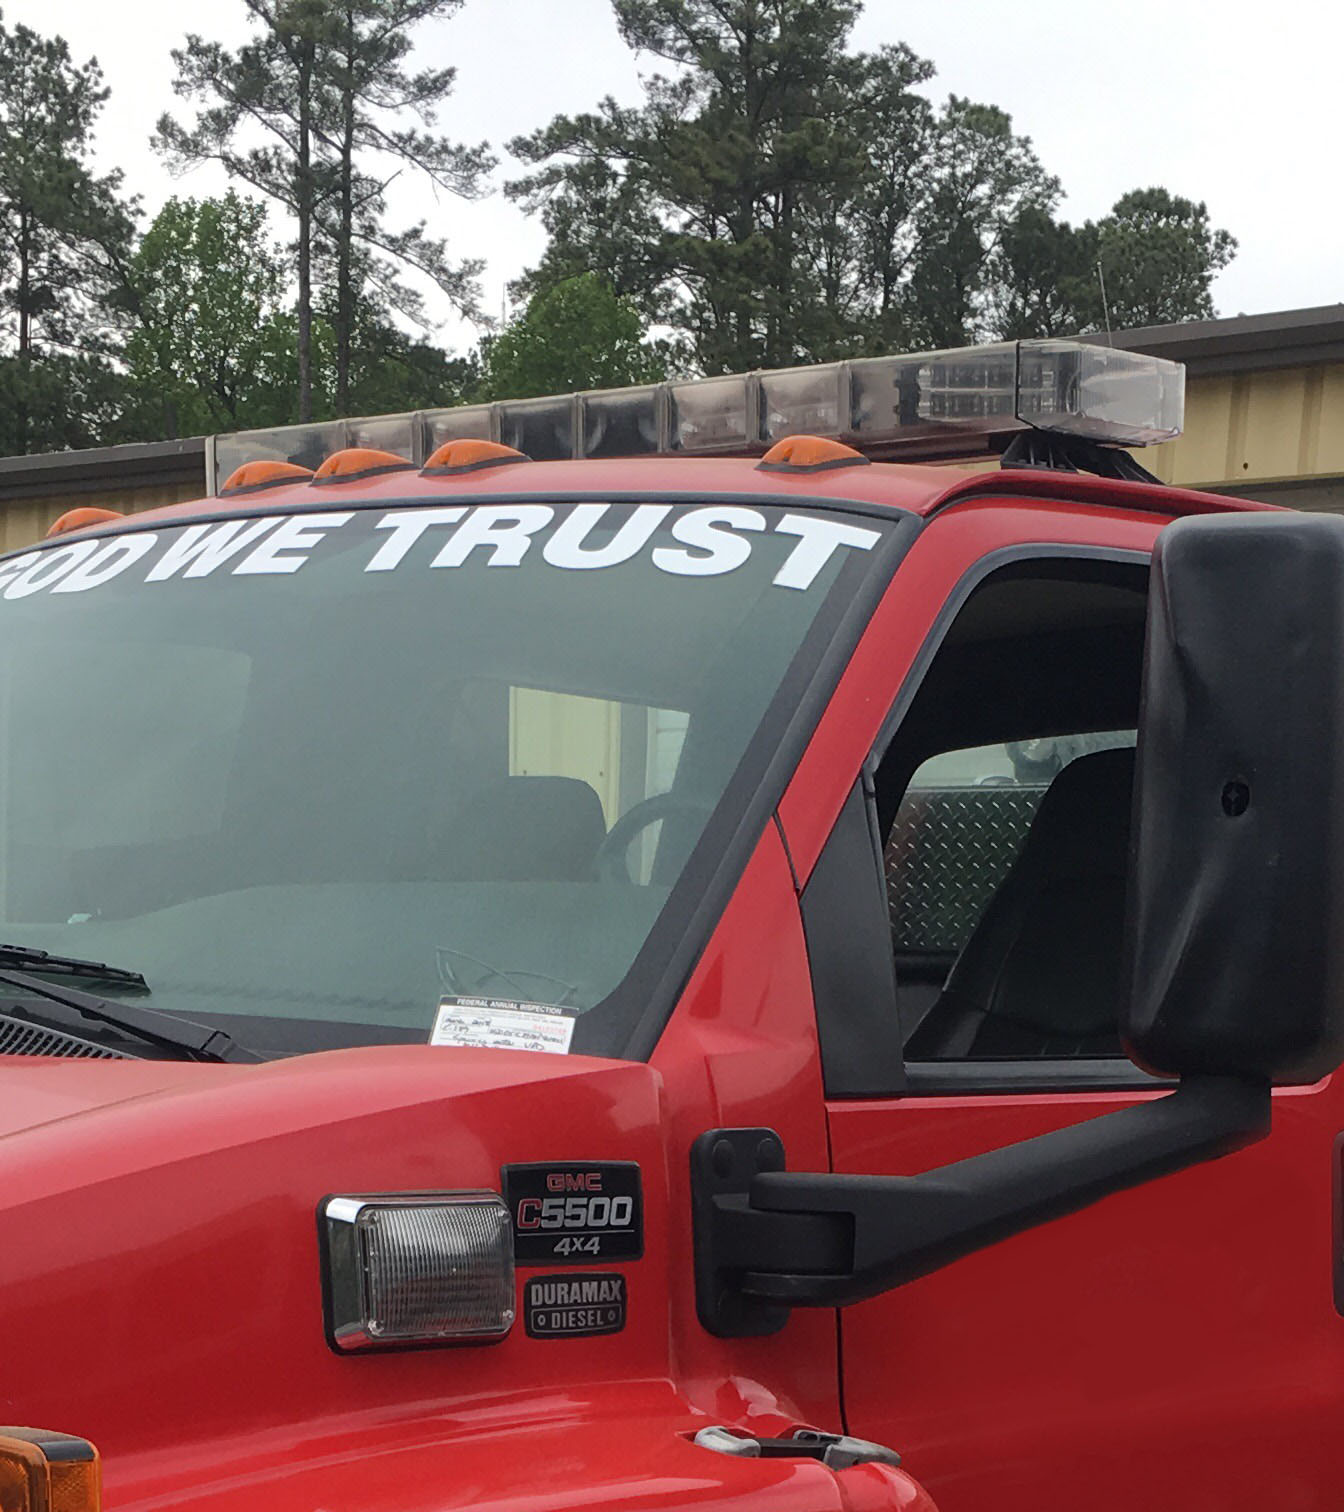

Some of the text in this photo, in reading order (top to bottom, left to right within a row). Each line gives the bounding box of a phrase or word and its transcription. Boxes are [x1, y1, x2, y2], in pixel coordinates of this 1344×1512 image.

[144, 513, 357, 582] WE
[364, 503, 882, 591] TRUST
[456, 998, 562, 1015] FEDERAL ANNUAL INSPECTION
[546, 1173, 603, 1192] GMC
[517, 1196, 633, 1230] C5500
[530, 1279, 623, 1306] DURAMAX
[551, 1306, 605, 1328] DIESEL
